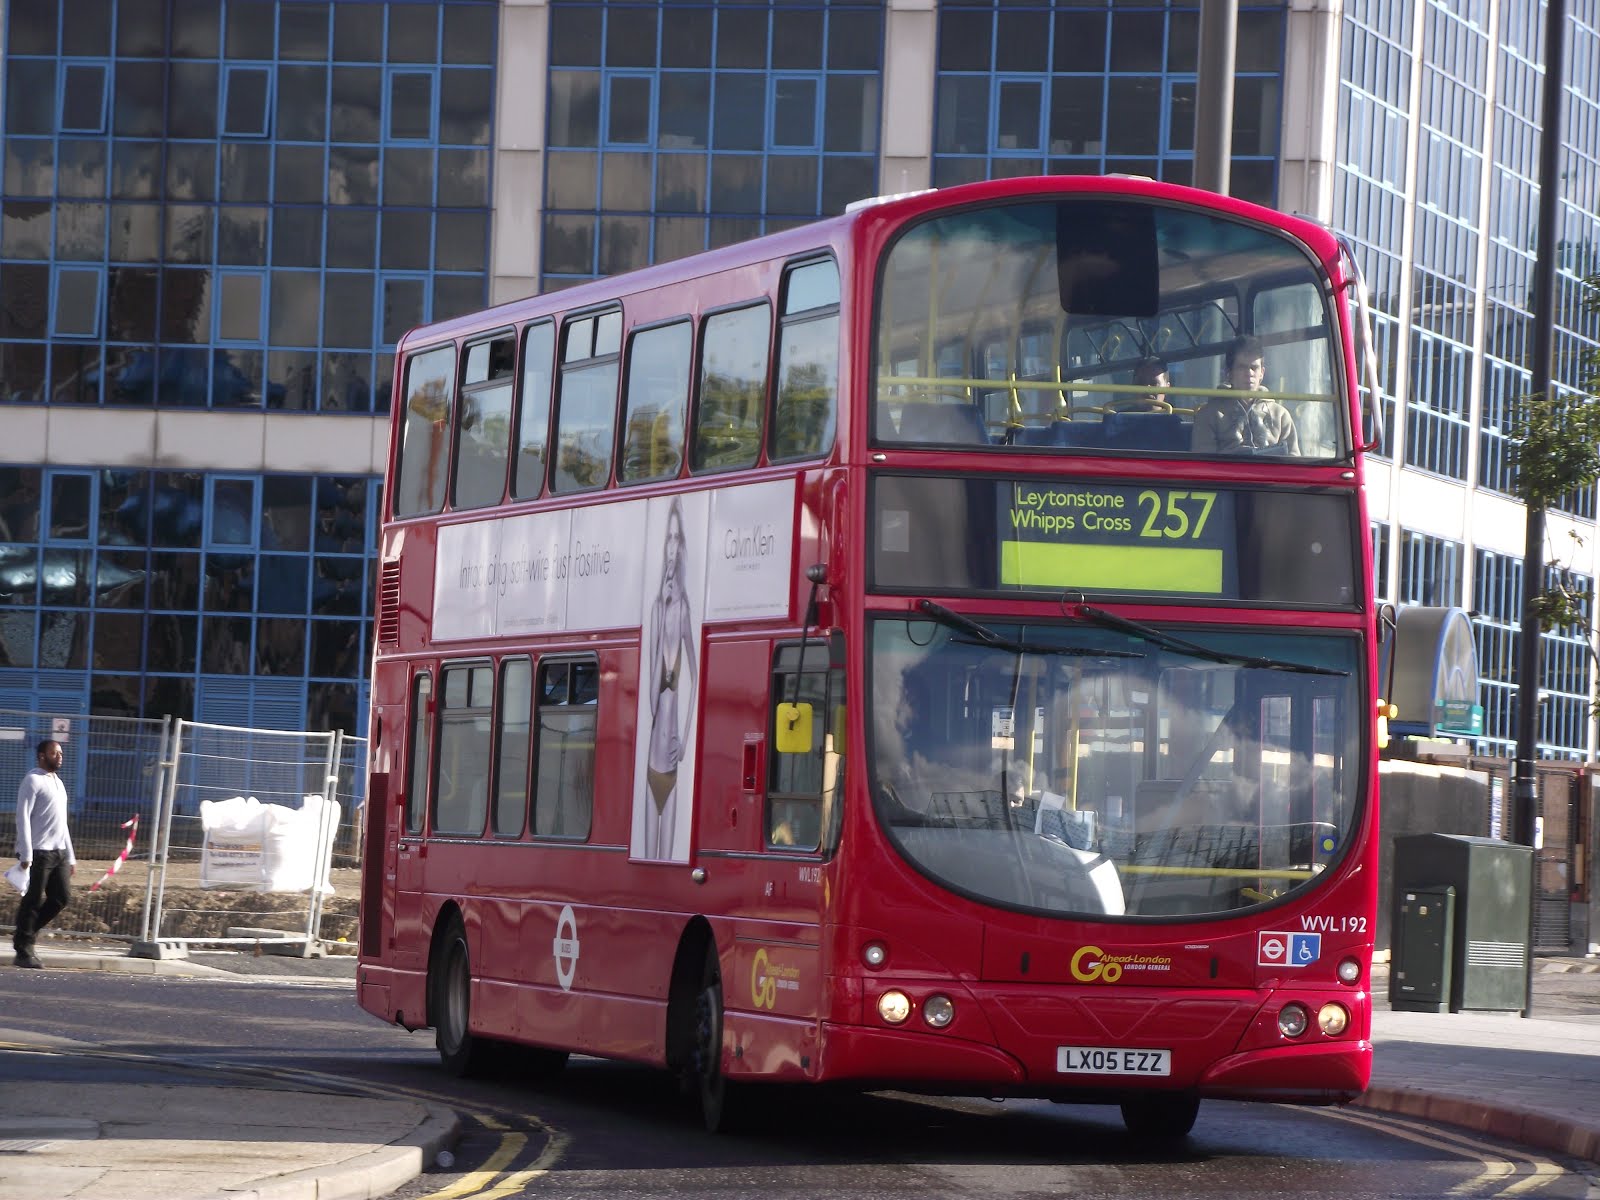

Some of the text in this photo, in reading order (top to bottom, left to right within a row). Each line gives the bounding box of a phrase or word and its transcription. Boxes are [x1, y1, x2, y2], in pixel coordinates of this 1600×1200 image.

[1017, 487, 1125, 510] Leytonstone
[1010, 509, 1132, 534] Whipps Cross
[1138, 490, 1217, 539] 257
[575, 540, 611, 577] Positive
[1301, 915, 1367, 933] WVL192
[1070, 945, 1122, 982] Go
[1101, 954, 1171, 965] Ahead-London
[752, 948, 776, 1010] Go
[1066, 1050, 1162, 1071] LX05 EZZ
